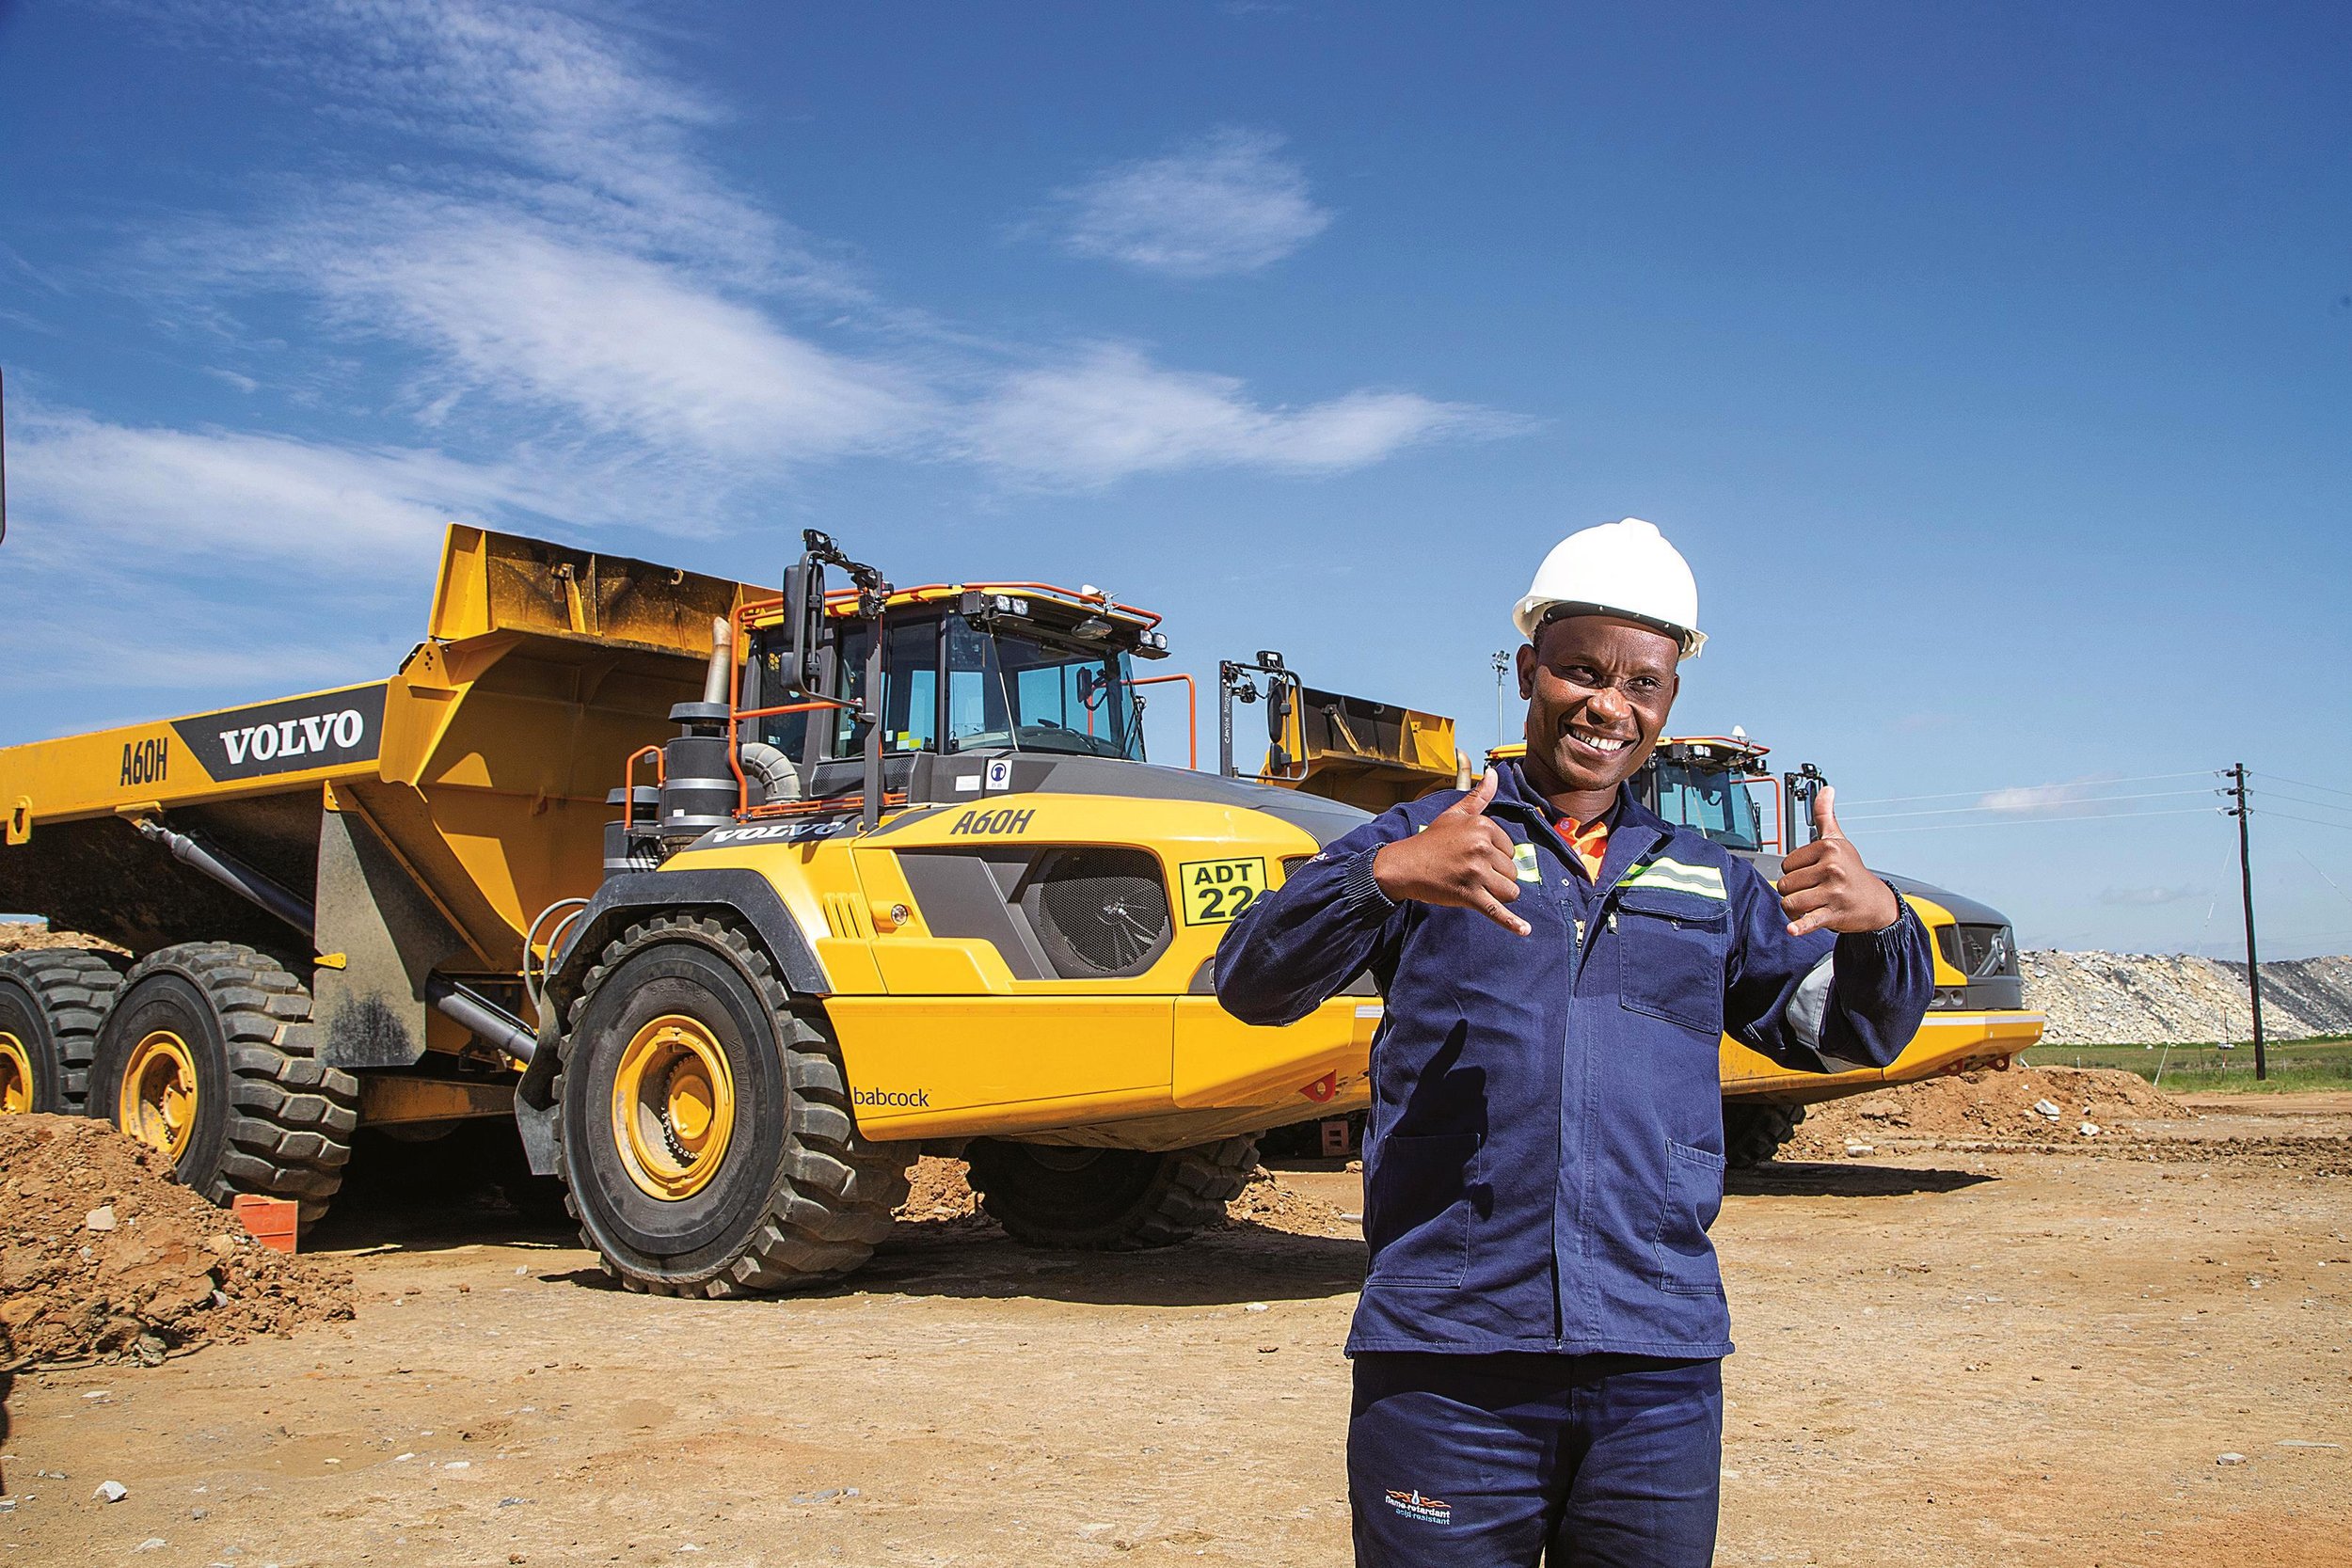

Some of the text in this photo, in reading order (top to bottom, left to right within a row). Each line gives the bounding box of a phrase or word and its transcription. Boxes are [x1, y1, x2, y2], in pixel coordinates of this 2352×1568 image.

[219, 709, 364, 765] VOLVO
[120, 736, 168, 786] A60H
[712, 821, 846, 843] VOLVO
[949, 809, 1037, 834] A60H
[1194, 863, 1253, 885] ADT
[1198, 886, 1253, 919] 22
[853, 1086, 930, 1107] babcock
